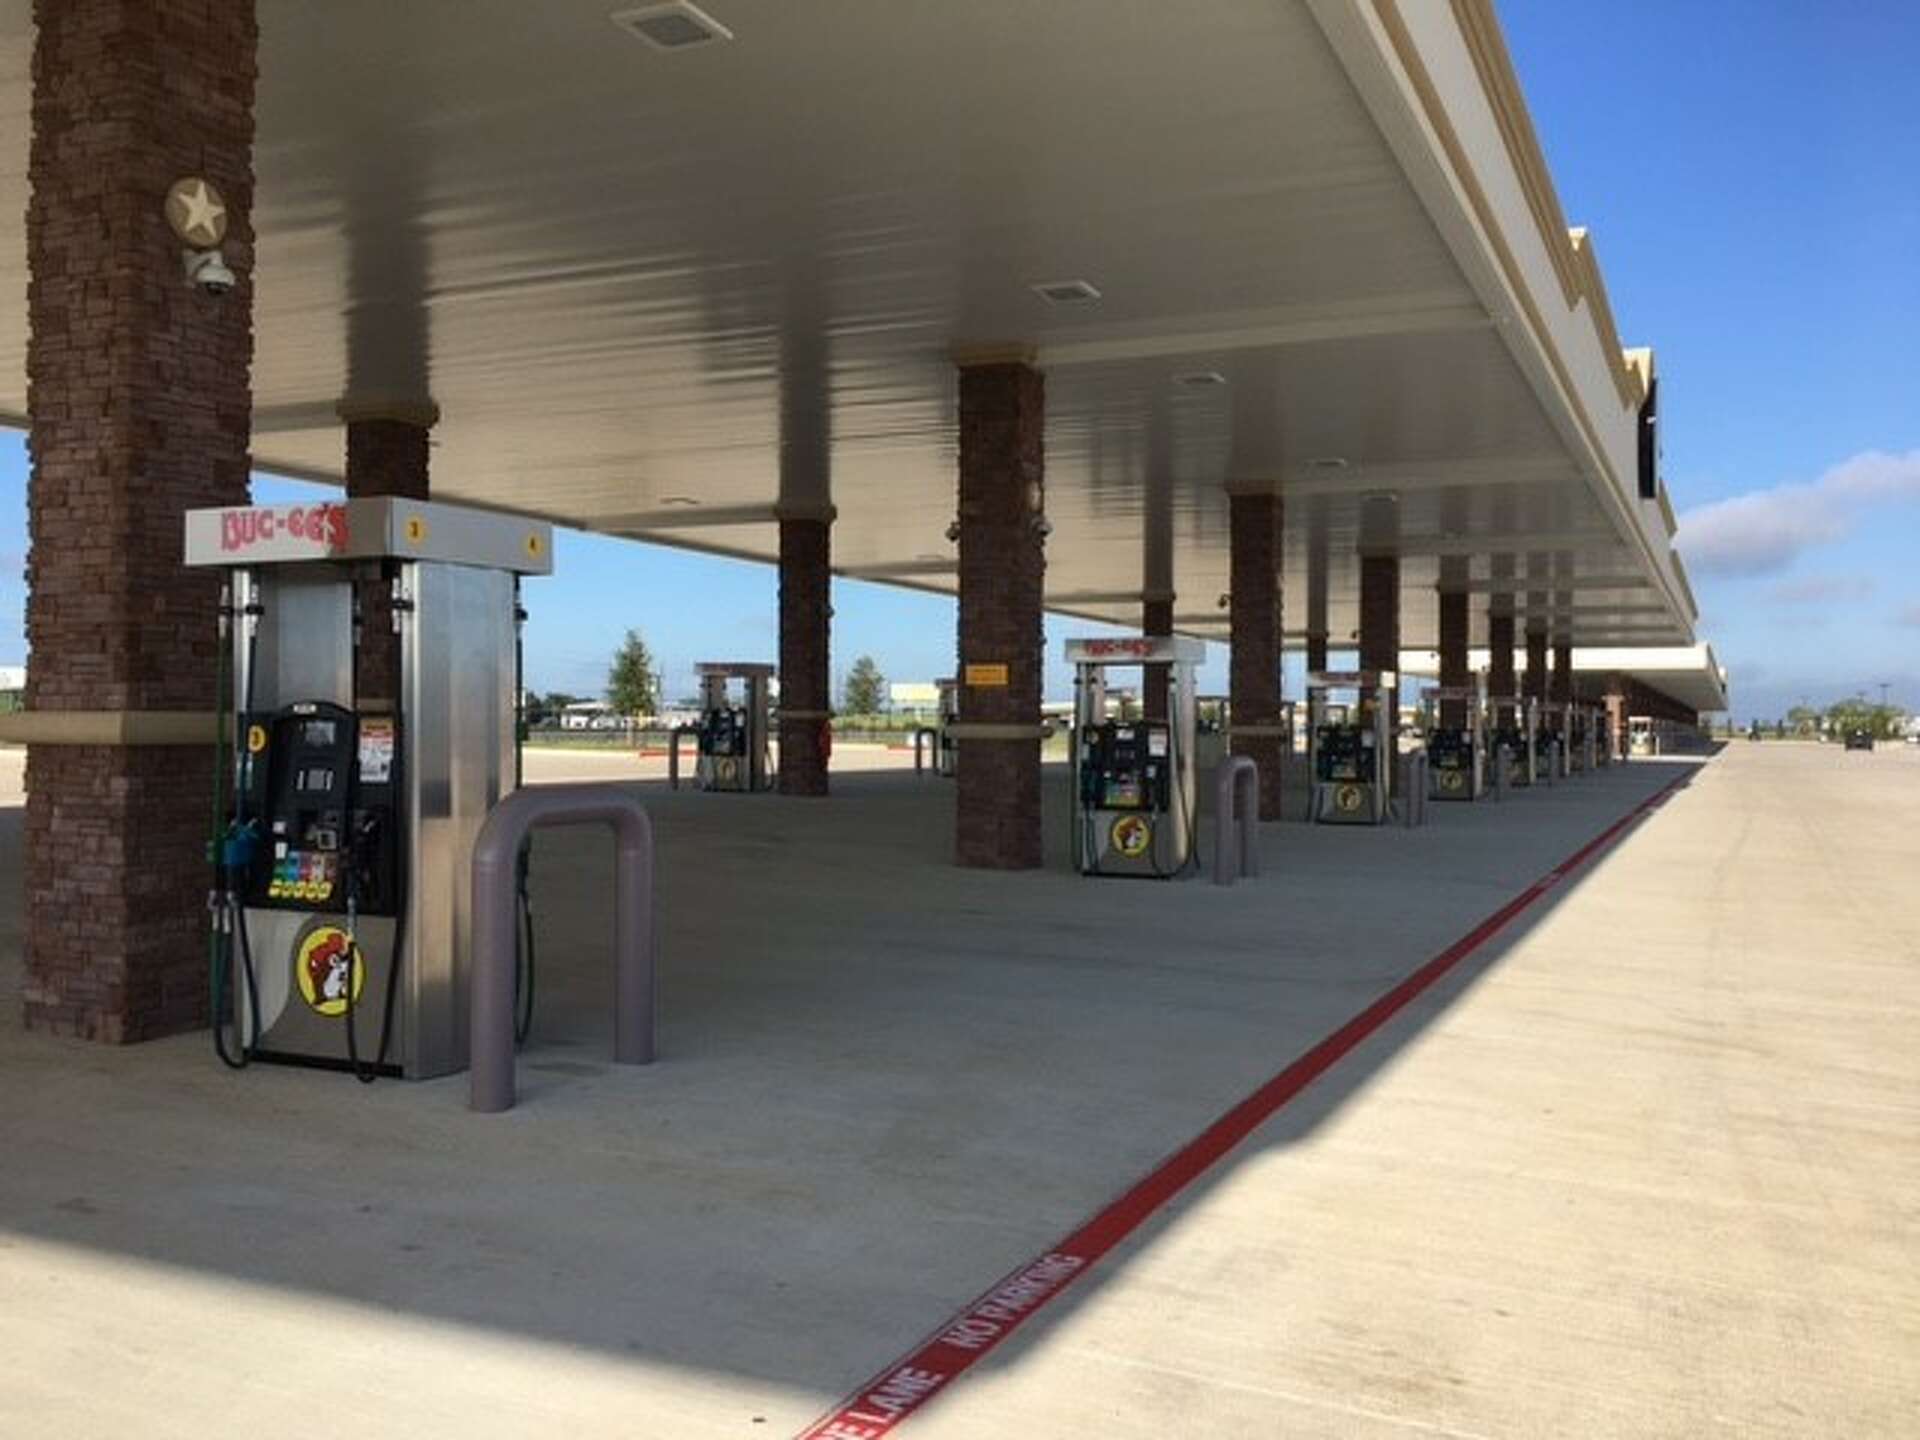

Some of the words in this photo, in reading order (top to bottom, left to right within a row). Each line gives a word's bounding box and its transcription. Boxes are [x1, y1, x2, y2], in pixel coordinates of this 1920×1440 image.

[846, 1367, 944, 1424] LANE
[940, 1317, 1001, 1349] NO
[976, 1253, 1083, 1321] PARKING
